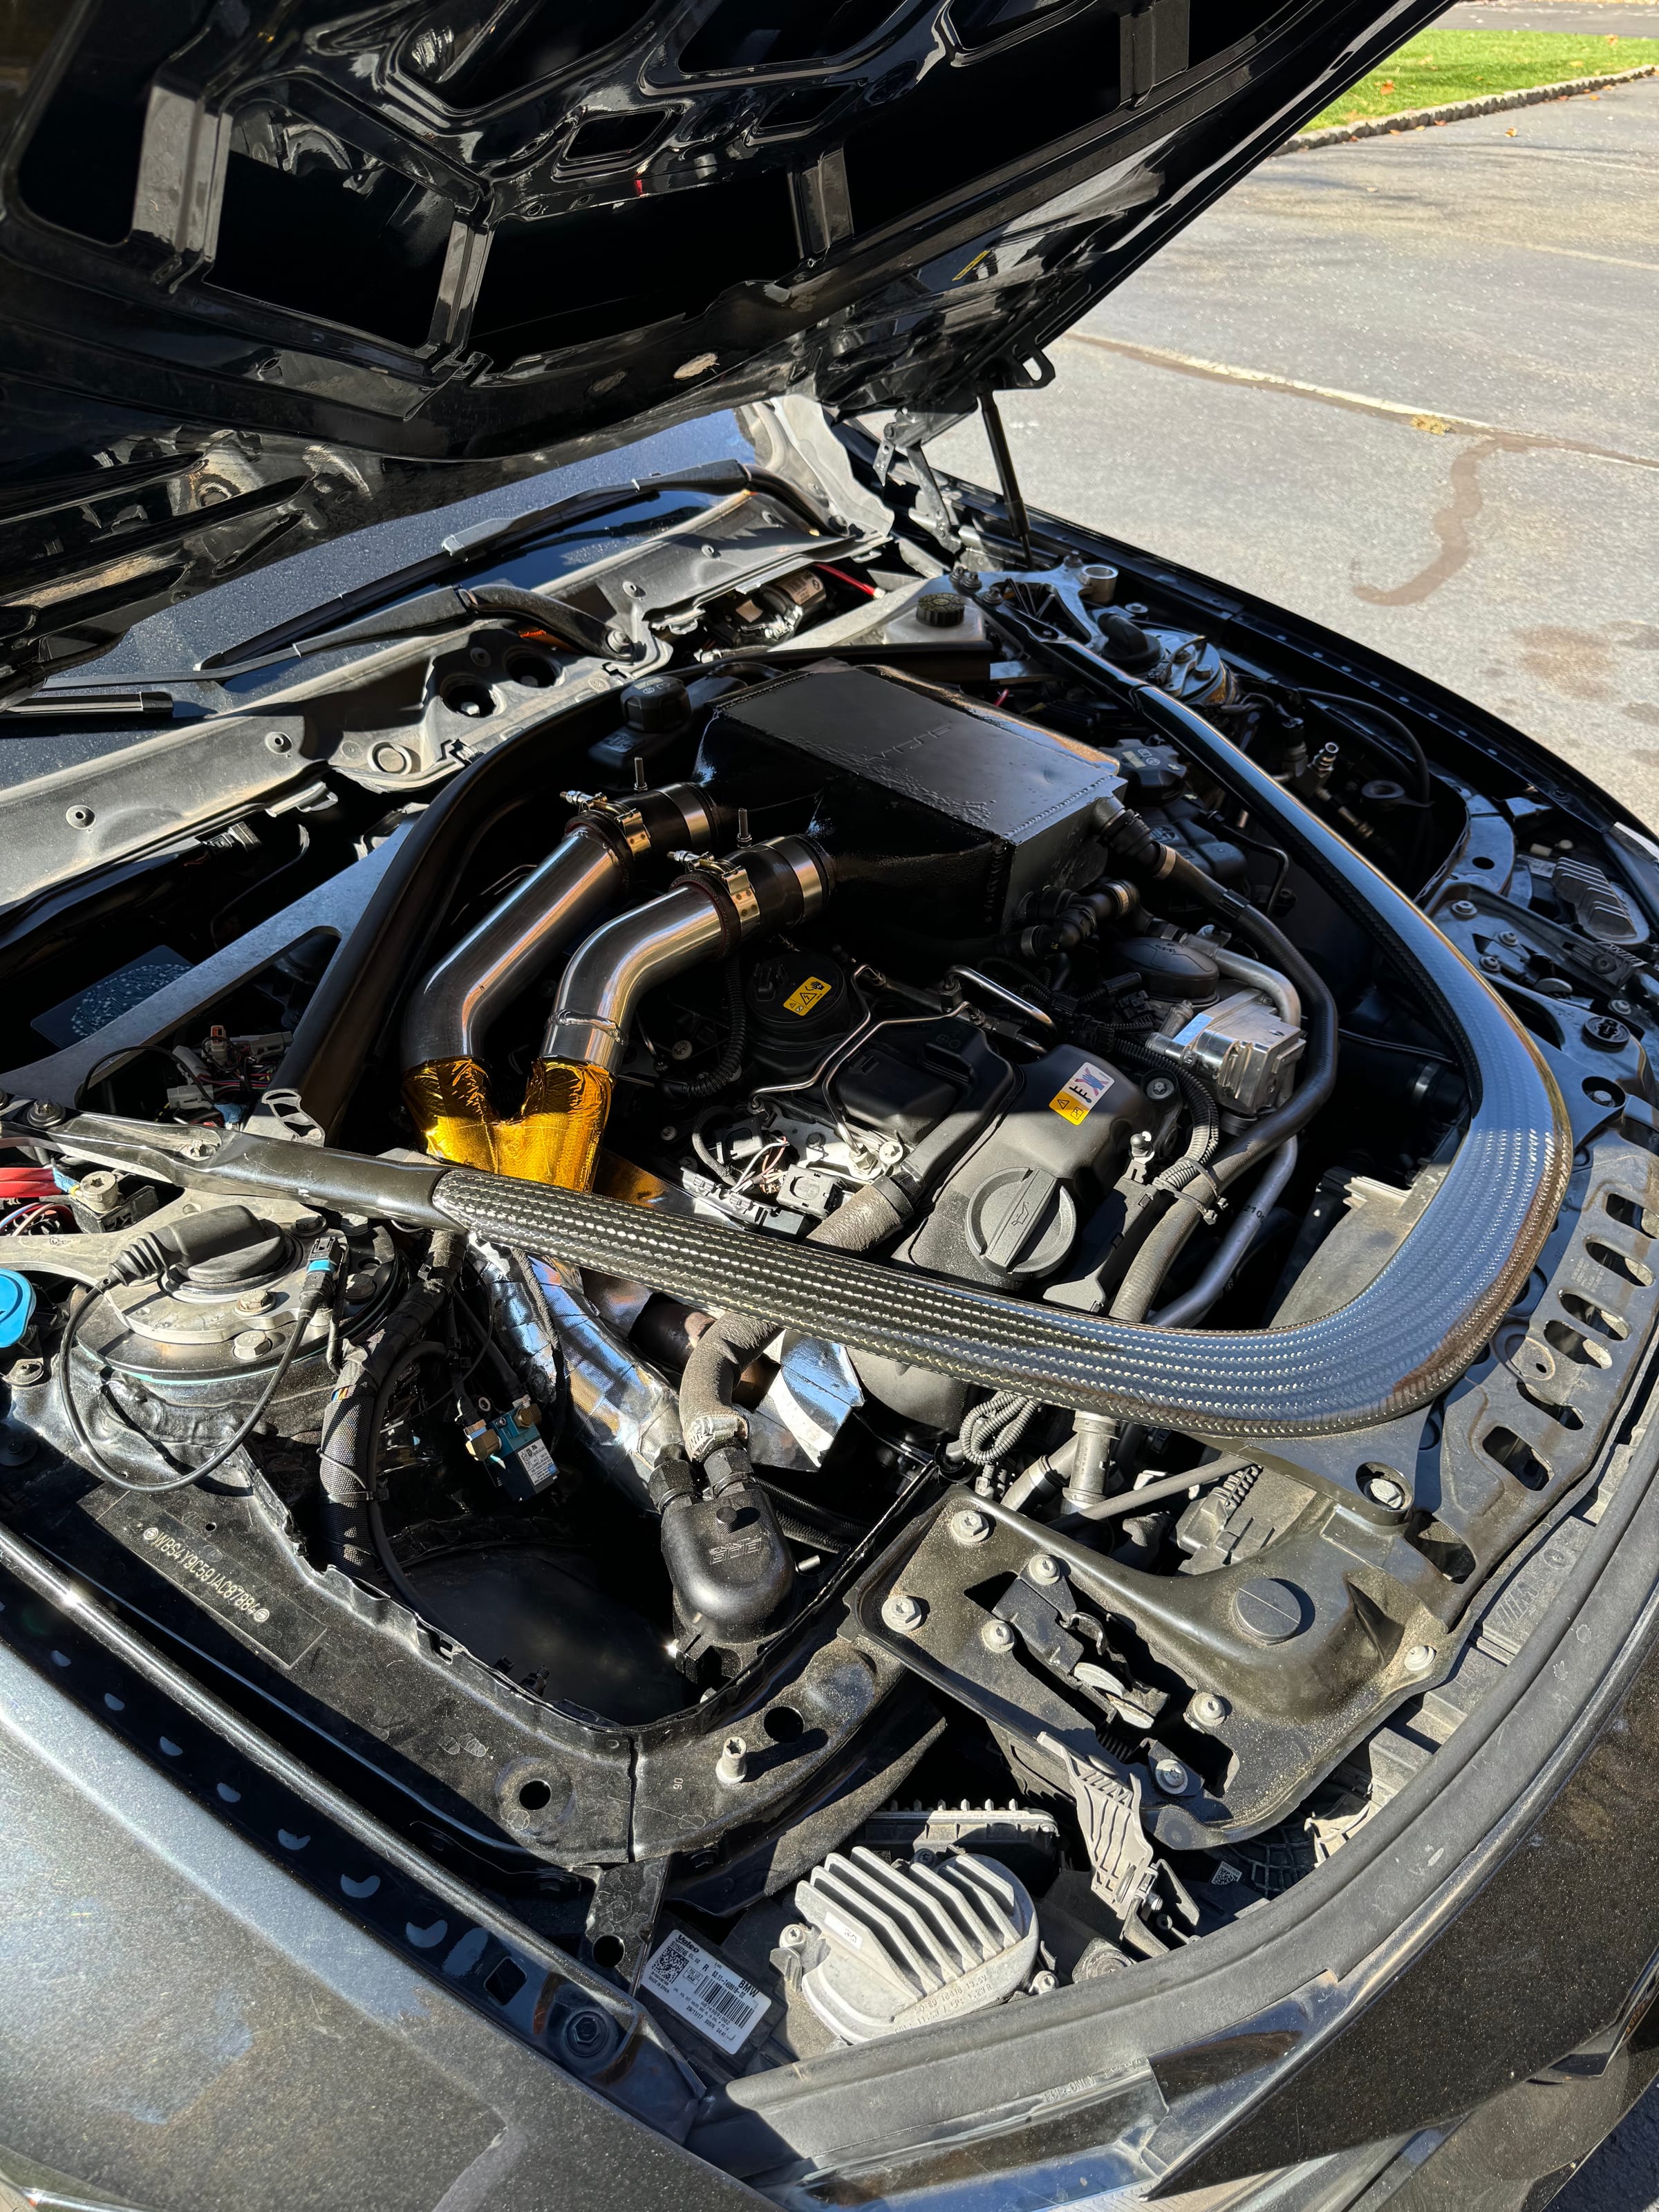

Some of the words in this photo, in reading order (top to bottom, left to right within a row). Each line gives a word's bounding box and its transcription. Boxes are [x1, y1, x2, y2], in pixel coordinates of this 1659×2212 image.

[675, 1933, 700, 1953] Valeo
[702, 1963, 710, 1972] R
[737, 1978, 760, 1998] BMW
